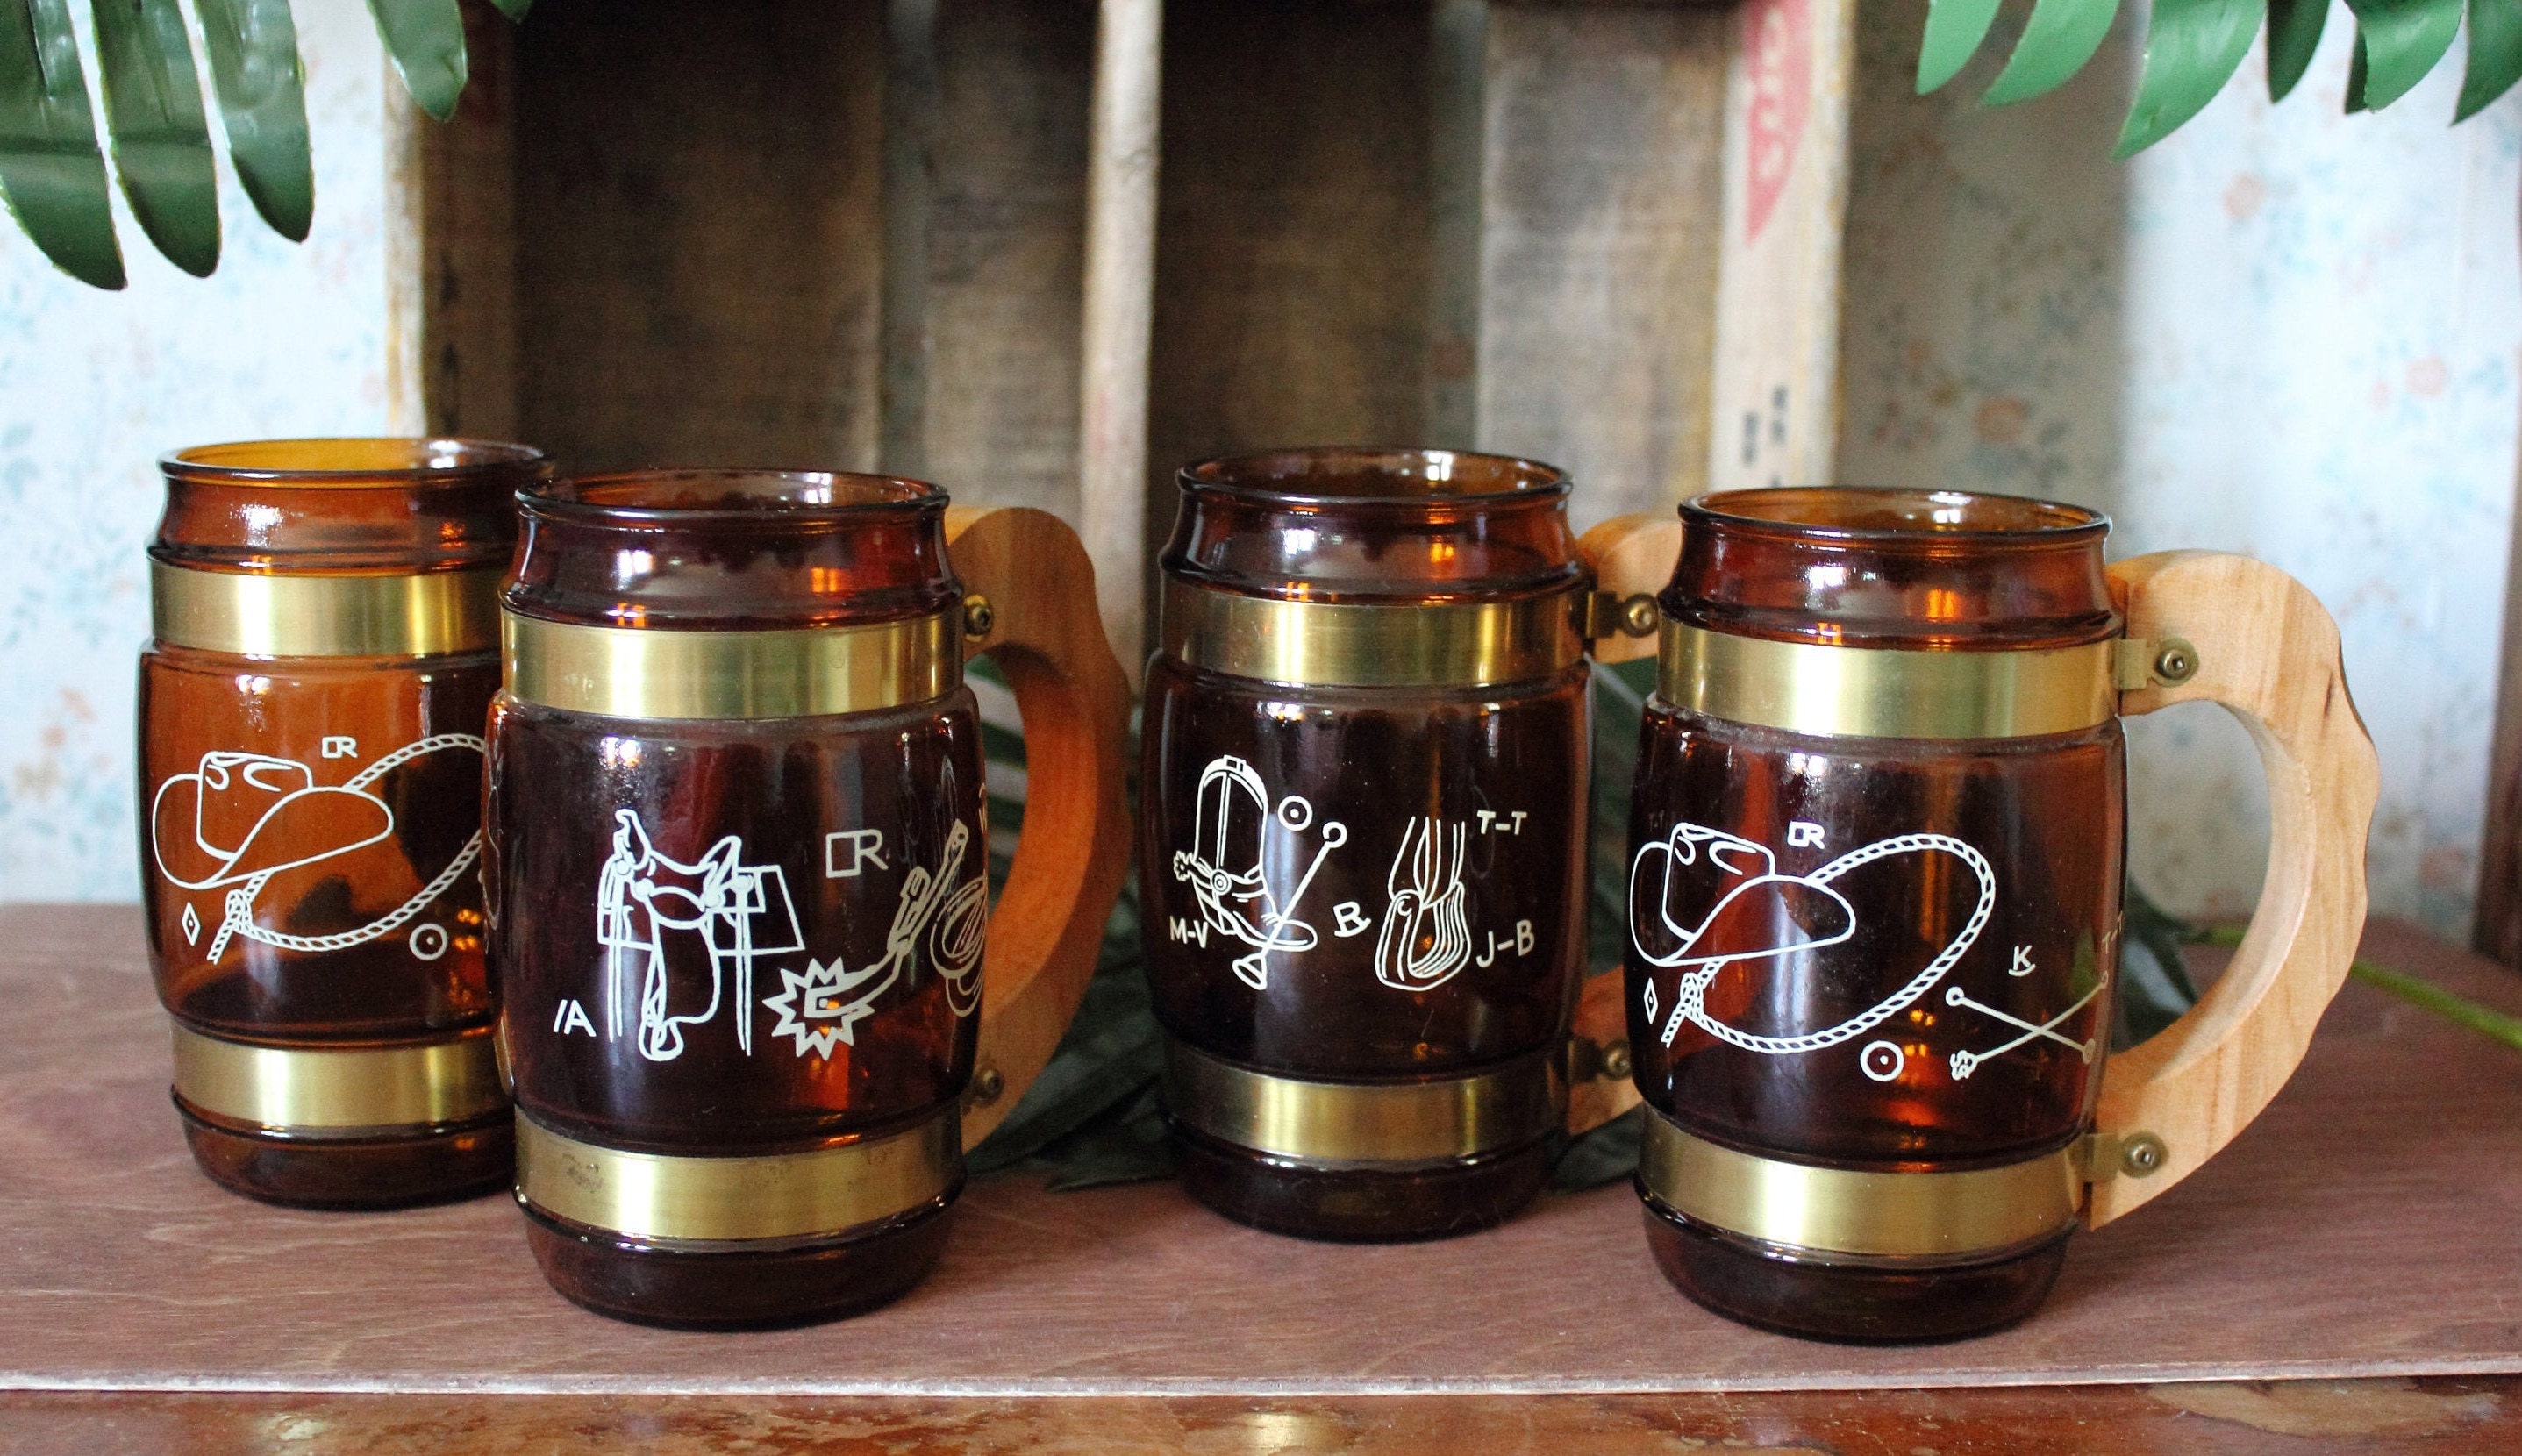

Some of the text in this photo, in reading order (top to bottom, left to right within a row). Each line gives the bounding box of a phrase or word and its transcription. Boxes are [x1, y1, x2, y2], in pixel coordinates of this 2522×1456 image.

[1476, 810, 1528, 835] T-T
[1169, 915, 1209, 948] M-V
[1475, 919, 1535, 968] J-B
